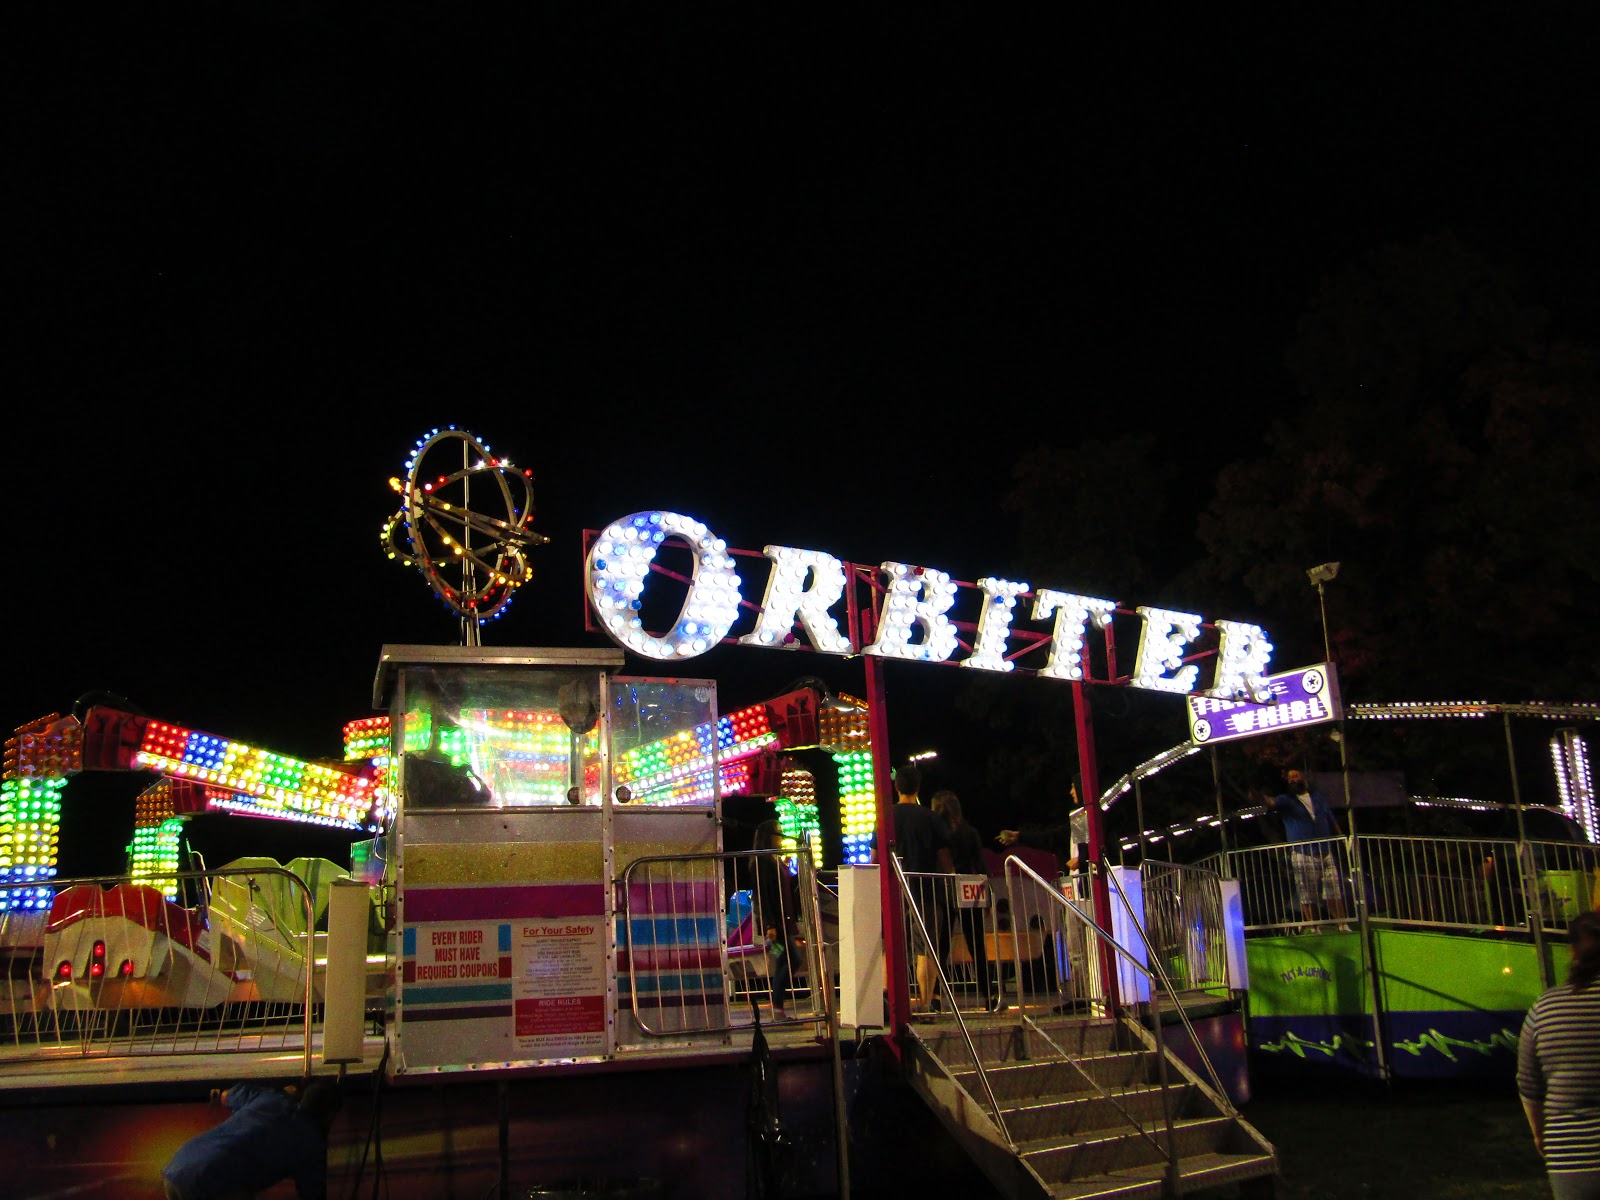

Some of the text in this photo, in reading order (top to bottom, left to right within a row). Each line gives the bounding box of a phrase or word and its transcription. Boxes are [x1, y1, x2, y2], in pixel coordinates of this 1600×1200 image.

[585, 511, 1276, 705] ORBITER
[1231, 697, 1324, 732] WHIRL
[963, 885, 985, 900] EXIT
[432, 930, 483, 945] EVERY RIDER
[523, 925, 595, 936] For Your Safety
[434, 946, 481, 962] MUST HAVE
[417, 963, 498, 981] REQUIRED COUPONS
[557, 998, 582, 1006] RULES
